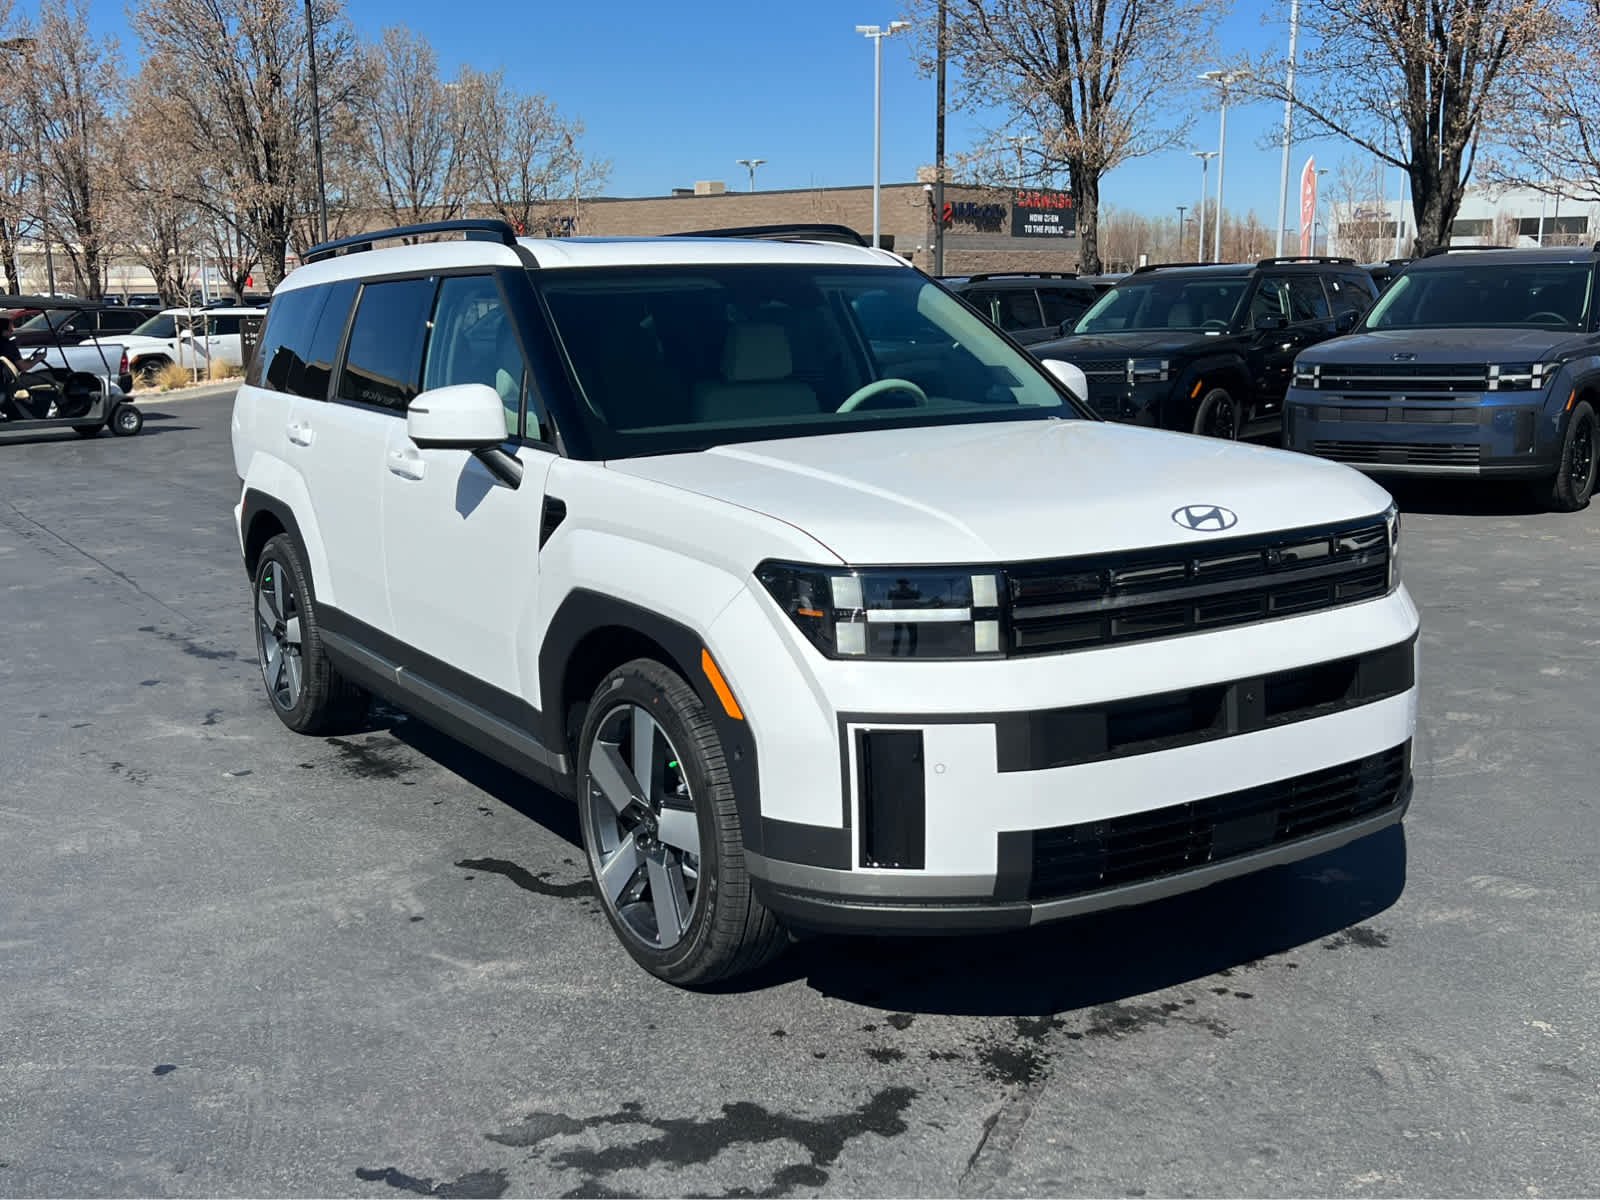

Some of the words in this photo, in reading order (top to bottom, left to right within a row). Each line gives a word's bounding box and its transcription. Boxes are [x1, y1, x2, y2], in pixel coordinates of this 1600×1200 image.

[1029, 214, 1043, 222] NOW
[1044, 214, 1059, 223] OPEN
[1024, 224, 1032, 233] TO
[1033, 225, 1043, 233] THE
[1044, 225, 1064, 234] PUBLIC
